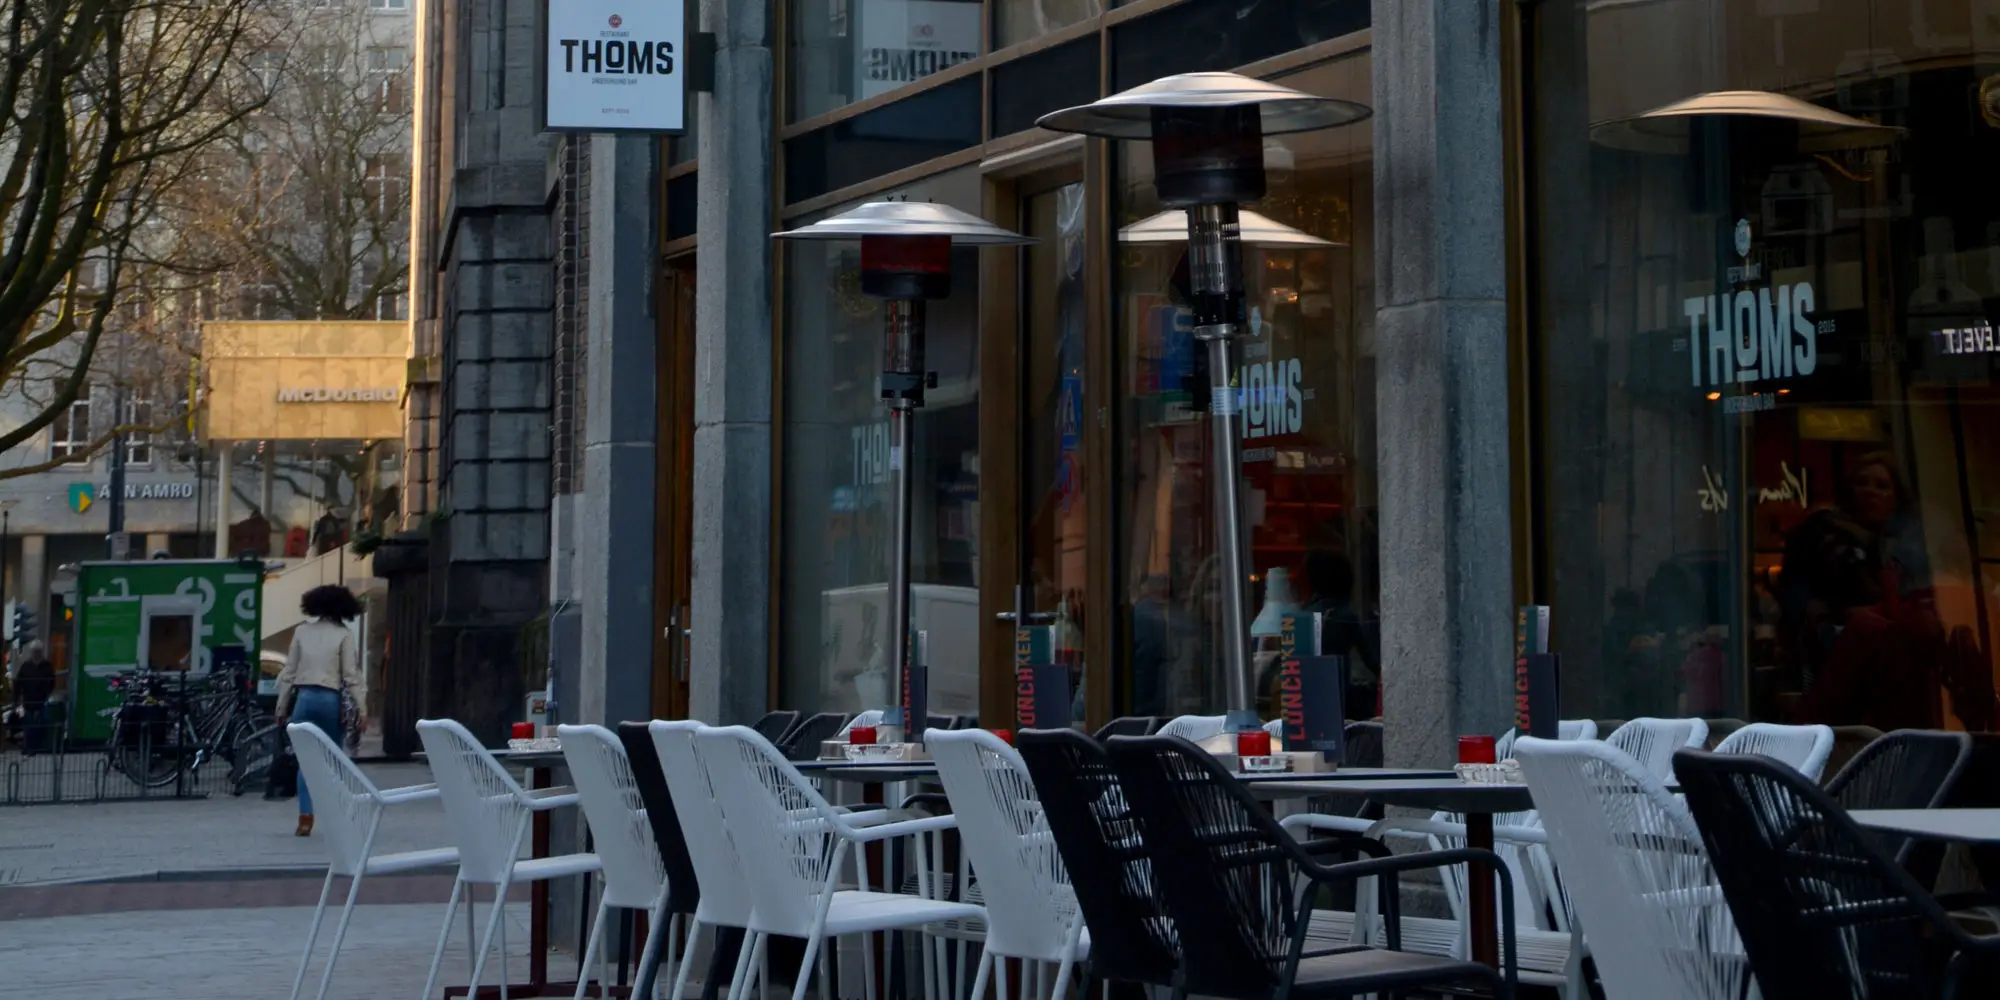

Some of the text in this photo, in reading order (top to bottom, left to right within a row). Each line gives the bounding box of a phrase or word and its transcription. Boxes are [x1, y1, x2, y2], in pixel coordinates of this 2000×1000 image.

[560, 39, 674, 75] THOMS
[1684, 282, 1817, 388] THOMS
[99, 484, 137, 499] AN
[1286, 659, 1306, 742] LUNCH
